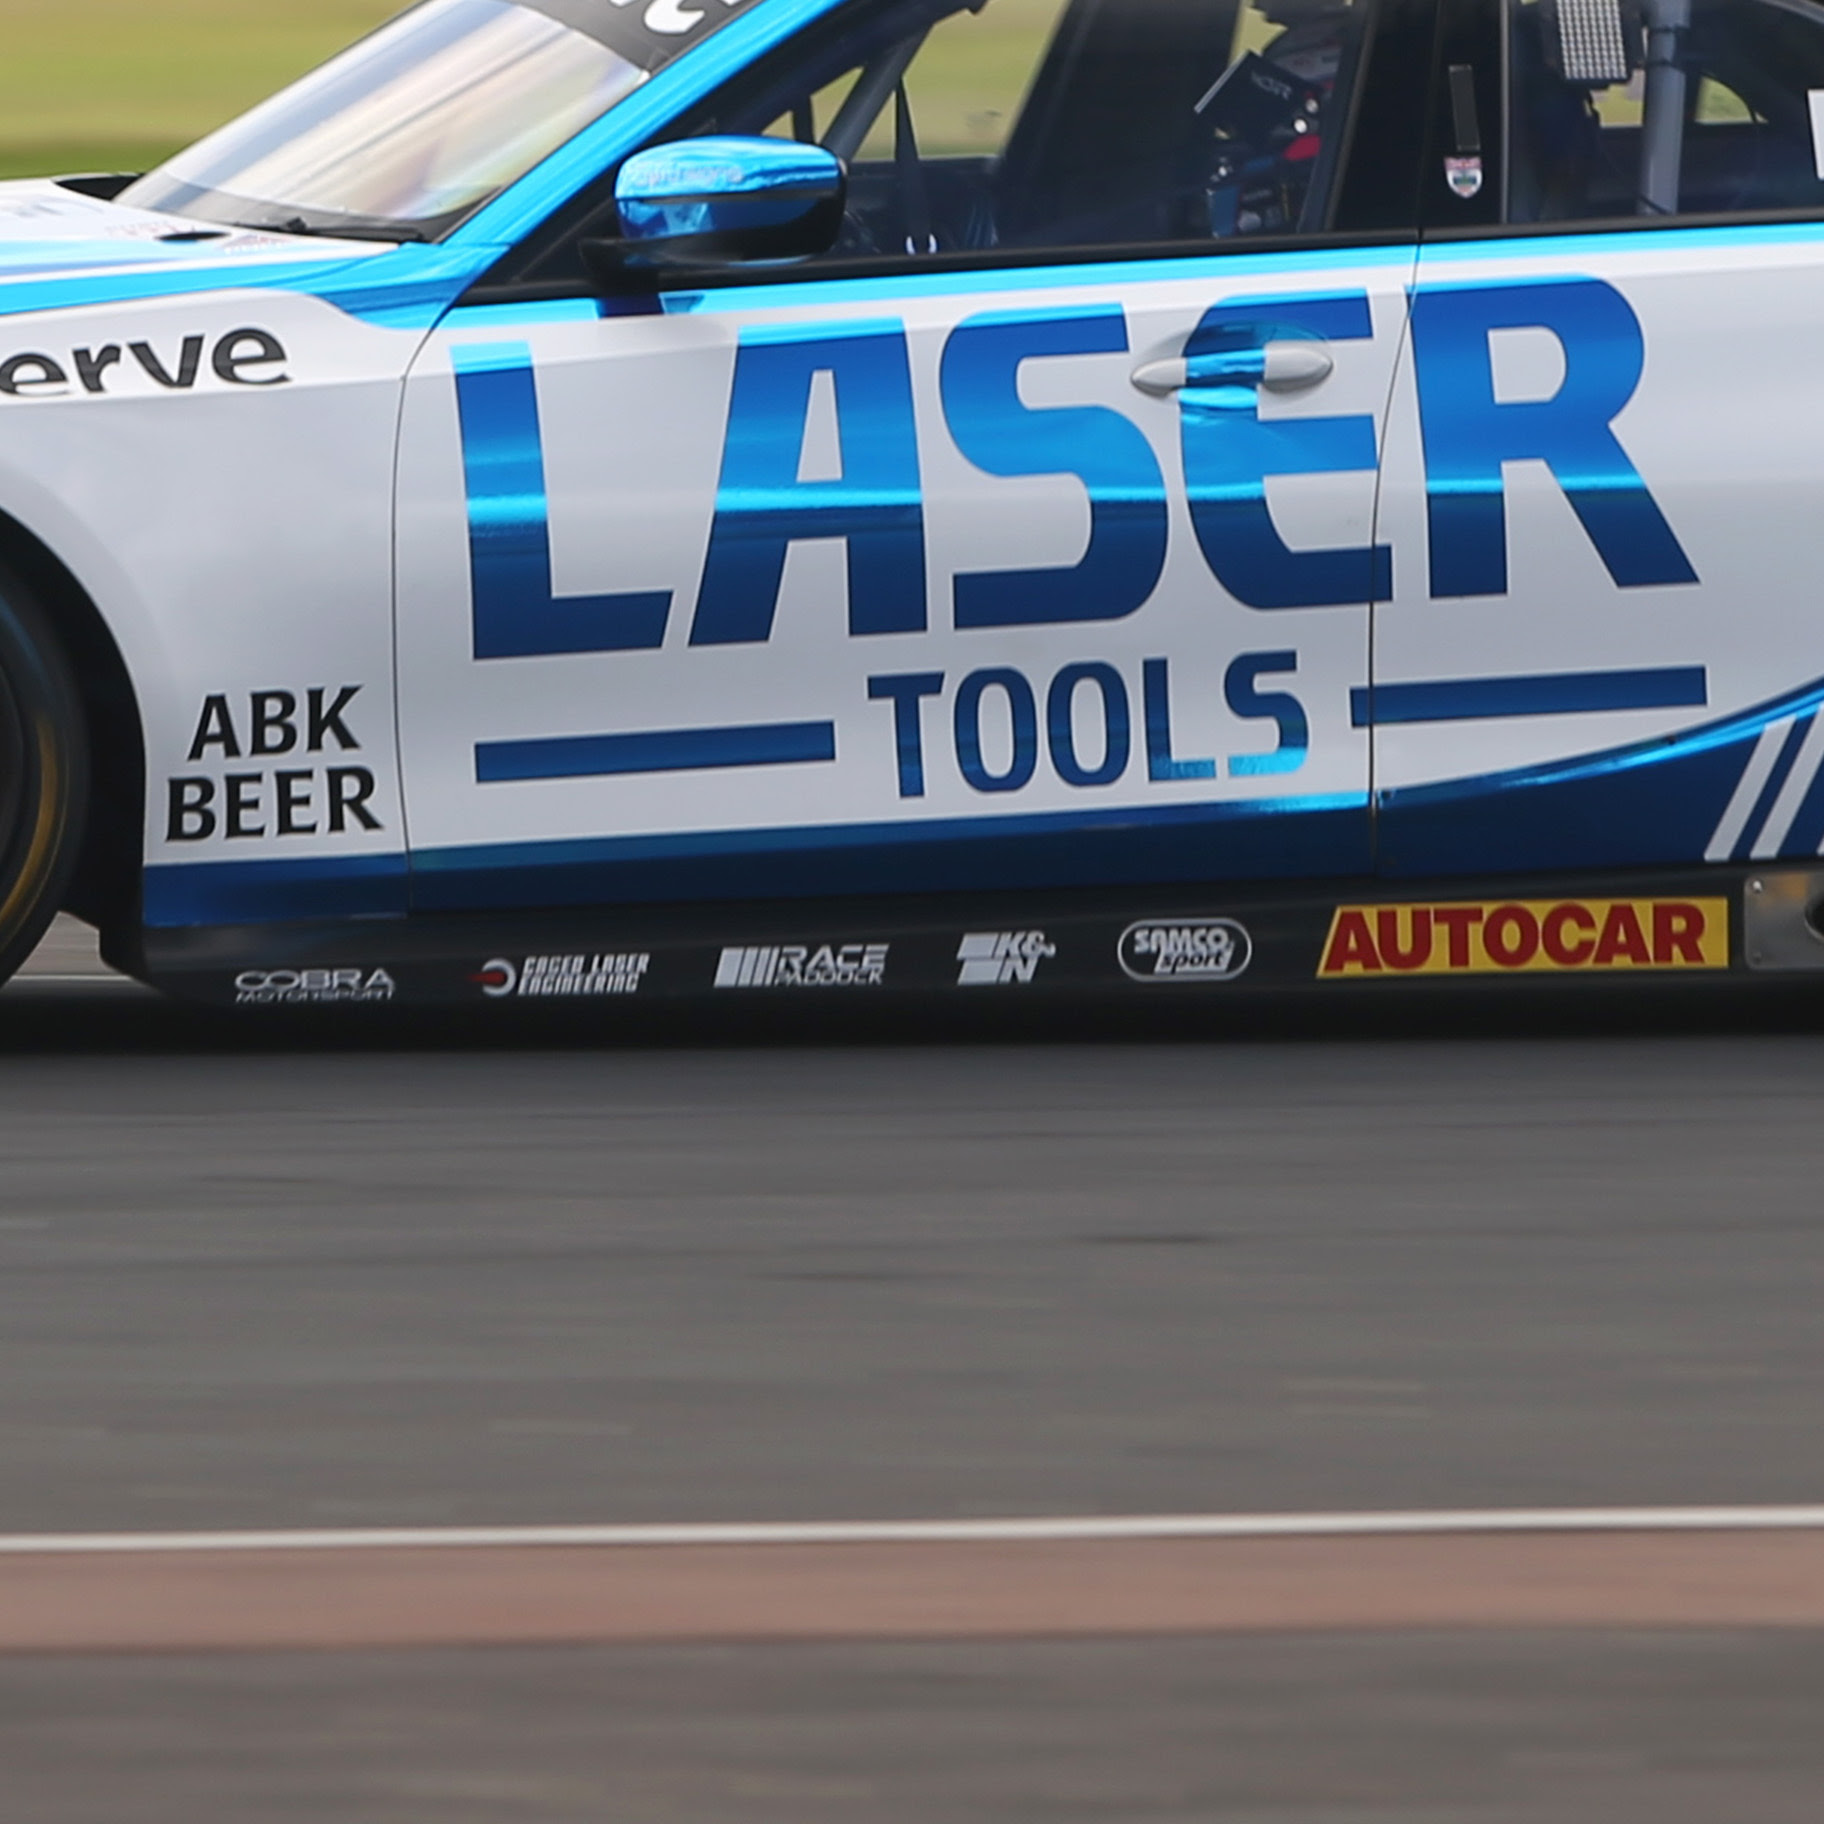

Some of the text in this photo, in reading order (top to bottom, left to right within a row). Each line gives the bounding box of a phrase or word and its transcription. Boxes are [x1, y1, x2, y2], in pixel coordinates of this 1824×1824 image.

[450, 272, 1701, 660] LASER
[187, 684, 365, 762] ABK
[865, 650, 1308, 798] TOOLS
[165, 764, 384, 843] BEER
[779, 944, 890, 971] RACE
[1134, 928, 1229, 954] SAMCO
[1161, 952, 1225, 975] sport
[1324, 902, 1706, 973] AUTOCAR
[235, 968, 396, 991] COBRA
